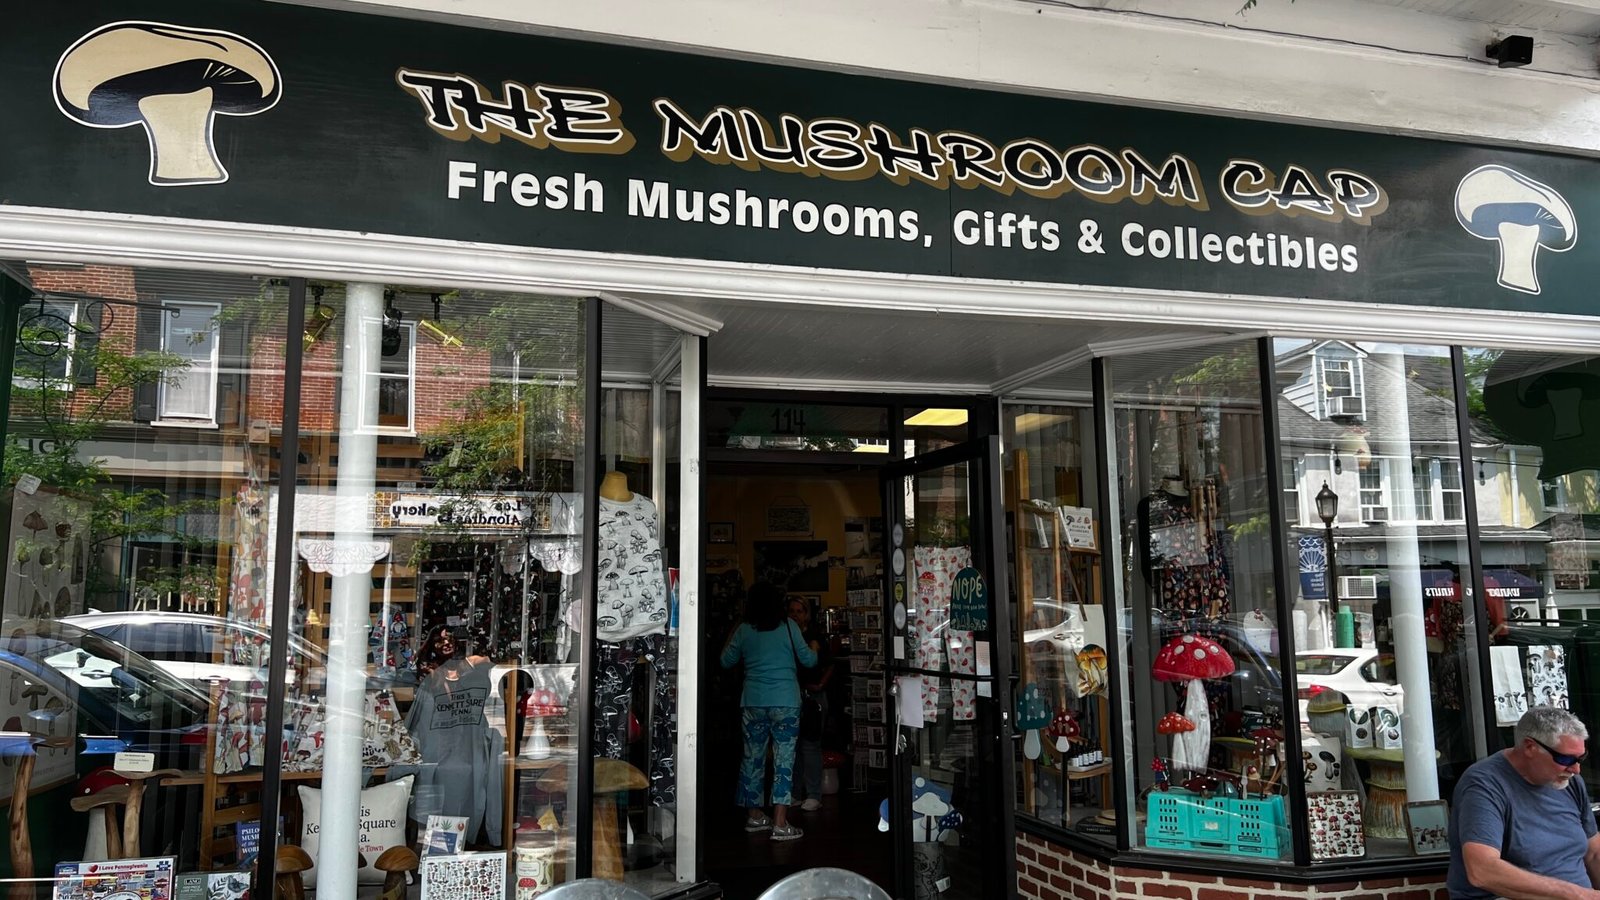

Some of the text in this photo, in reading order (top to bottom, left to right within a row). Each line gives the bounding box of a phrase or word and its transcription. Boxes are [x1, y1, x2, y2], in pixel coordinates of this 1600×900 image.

[398, 69, 1386, 221] THE MUSHROOM CAP
[447, 160, 1359, 273] Fresh Mushrooms, Gifts & Collectibles
[771, 408, 807, 435] 114
[952, 575, 984, 604] NOPE
[365, 844, 384, 853] Town
